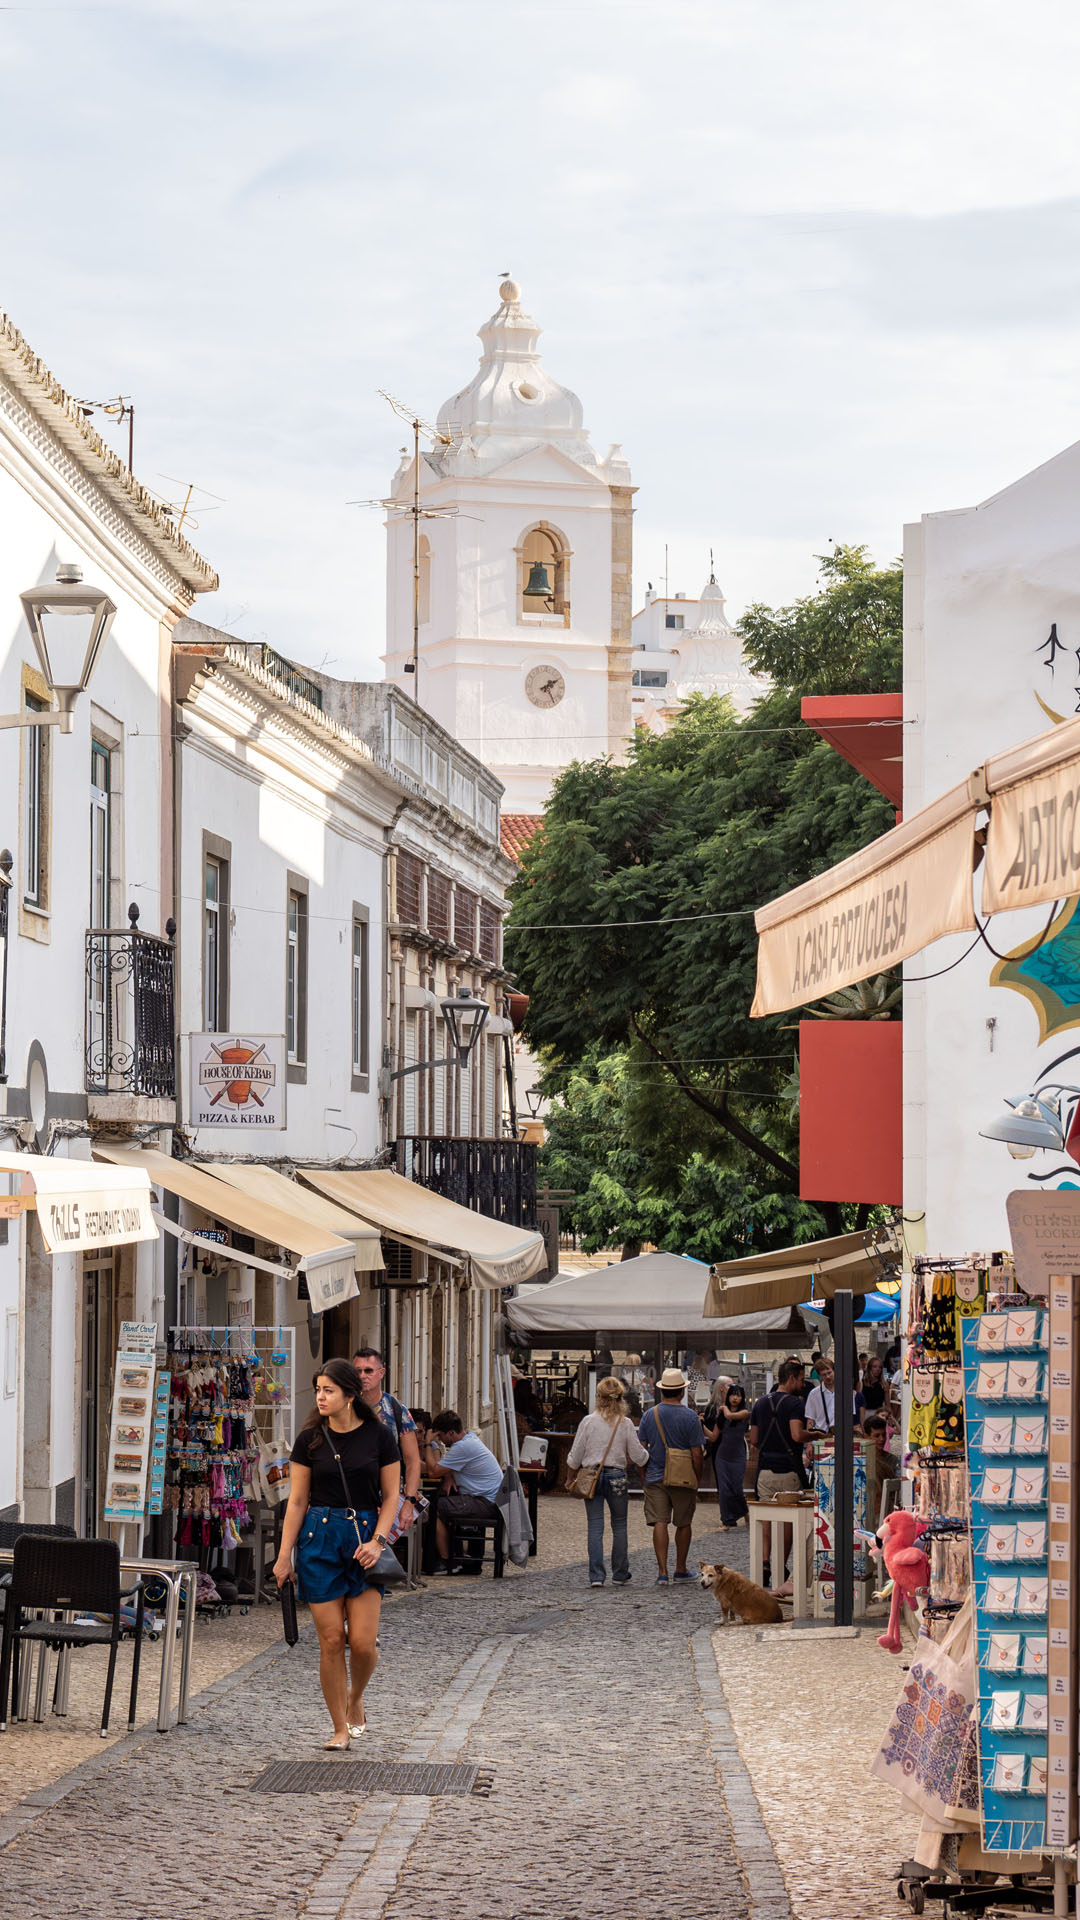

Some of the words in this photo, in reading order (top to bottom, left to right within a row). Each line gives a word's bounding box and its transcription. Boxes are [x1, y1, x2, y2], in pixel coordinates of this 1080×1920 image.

[792, 935, 800, 993] A
[802, 920, 828, 988] CASA
[830, 880, 907, 977] PORTUGUESA
[204, 1065, 232, 1079] HOUSE
[232, 1065, 244, 1079] OF
[244, 1066, 272, 1080] KEBAB
[199, 1113, 230, 1123] PIZZA
[230, 1114, 238, 1123] &
[240, 1114, 275, 1124] KEBAB
